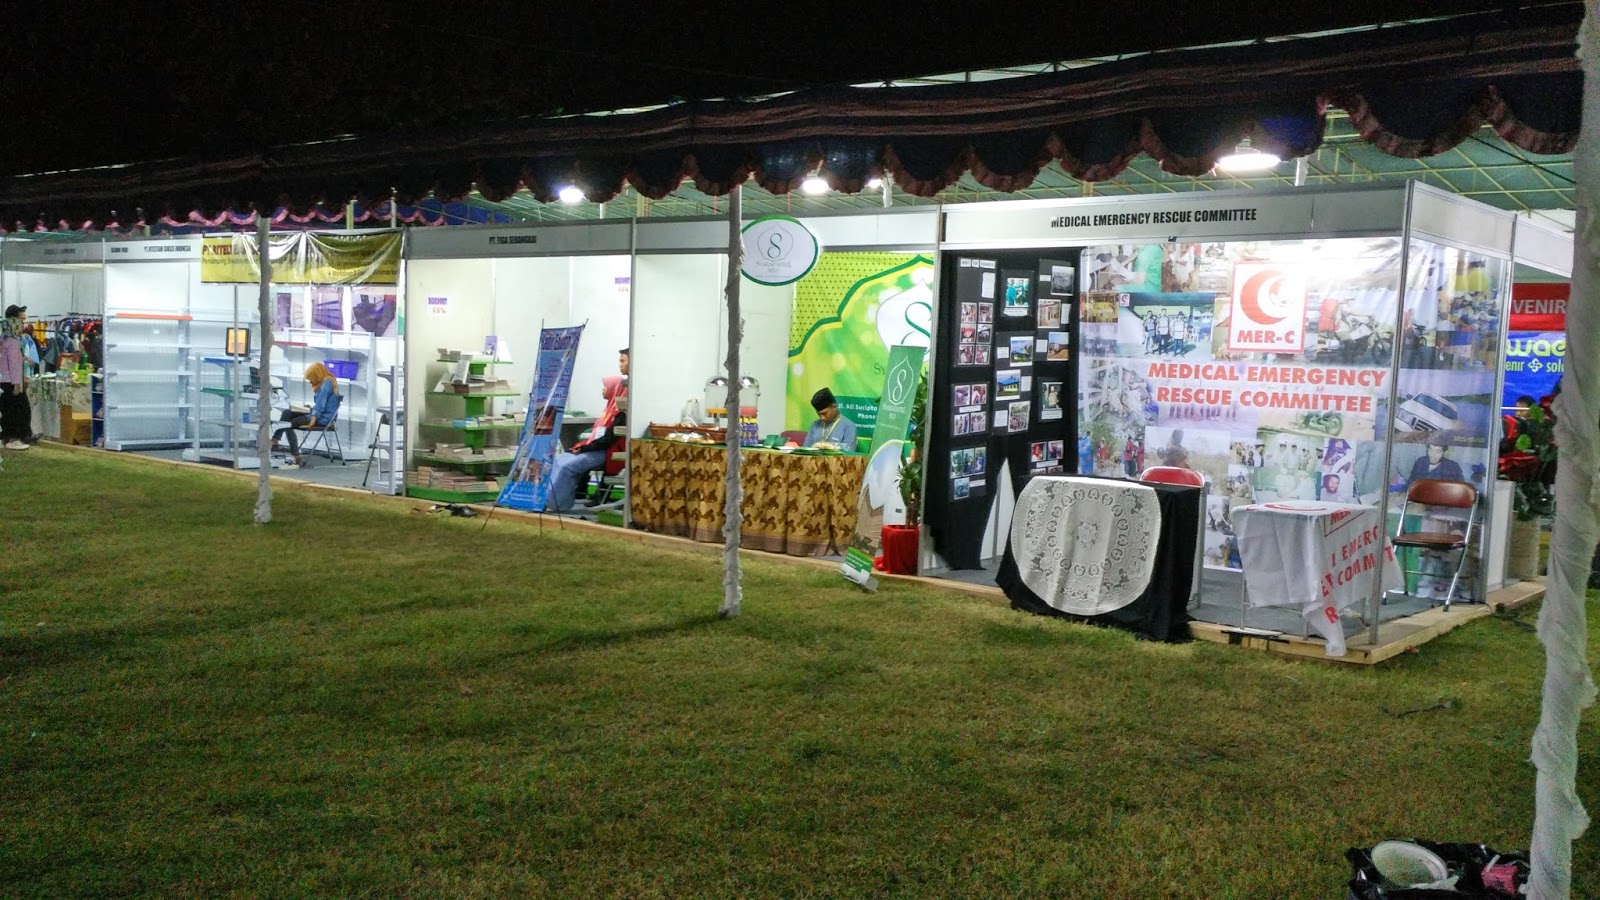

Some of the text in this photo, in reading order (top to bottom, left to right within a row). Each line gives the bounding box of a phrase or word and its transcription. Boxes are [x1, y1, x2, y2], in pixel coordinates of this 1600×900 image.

[1051, 208, 1257, 228] MEDICAL EMERGENCY RESCUE COMMITTEE
[1237, 330, 1295, 344] MER-C
[1148, 363, 1387, 387] MEDICAL EMERGENCY
[855, 404, 877, 412] Sucipto
[1157, 387, 1372, 412] RESCUE COMMITTEE
